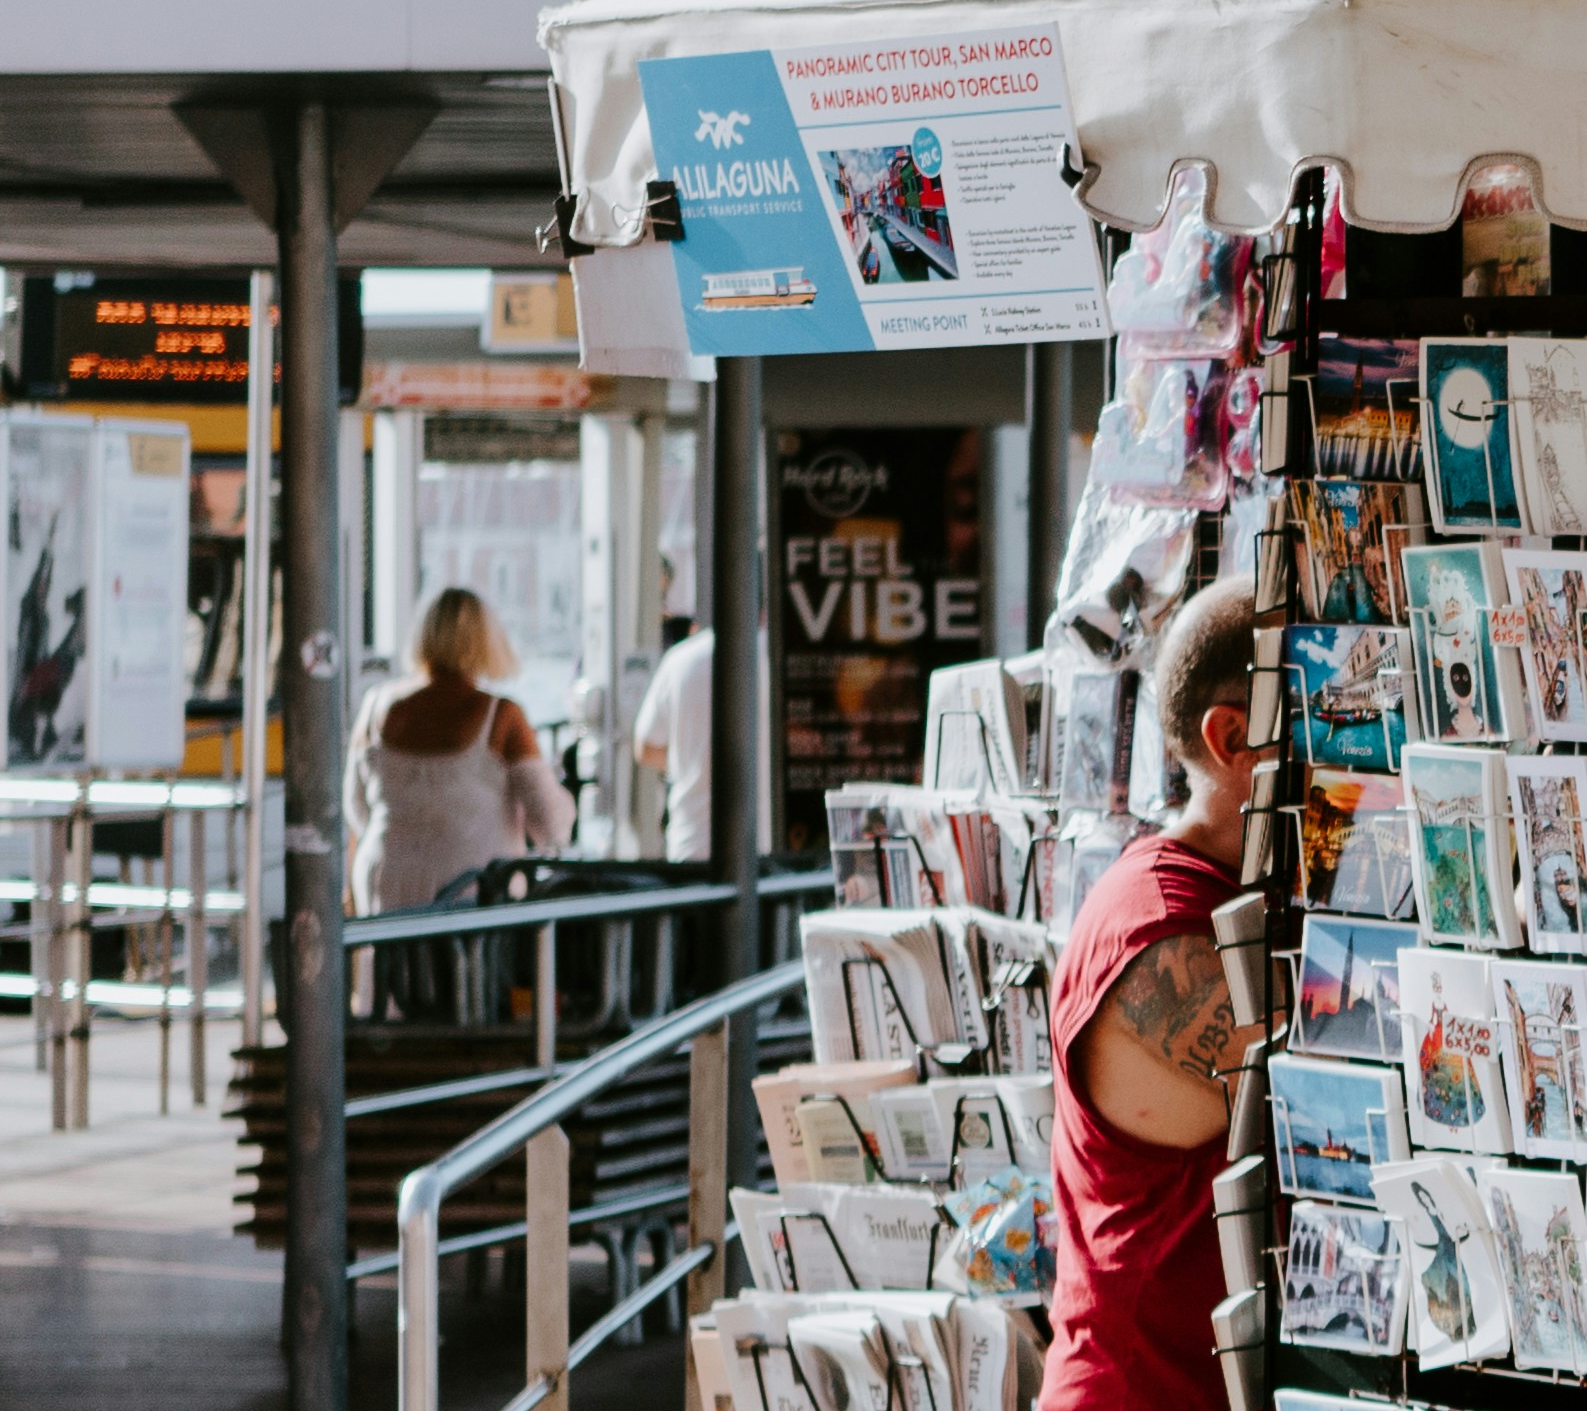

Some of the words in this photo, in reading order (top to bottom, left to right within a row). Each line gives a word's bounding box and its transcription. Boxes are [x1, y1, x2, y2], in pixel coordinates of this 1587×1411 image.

[787, 52, 875, 80] PANORAMIC
[878, 48, 910, 72] CITY
[912, 45, 959, 70] TOUR,
[962, 41, 990, 65] SAN
[994, 36, 1053, 61] MARCO
[811, 93, 821, 111] &
[824, 86, 888, 110] MURANO
[892, 81, 956, 105] BURANO
[957, 72, 1039, 99] TORCELLO
[673, 158, 800, 200] ALILAGUNA
[881, 318, 928, 335] MEETING
[931, 315, 968, 332] POINT
[787, 537, 913, 577] FEEL
[789, 578, 982, 643] VIBE
